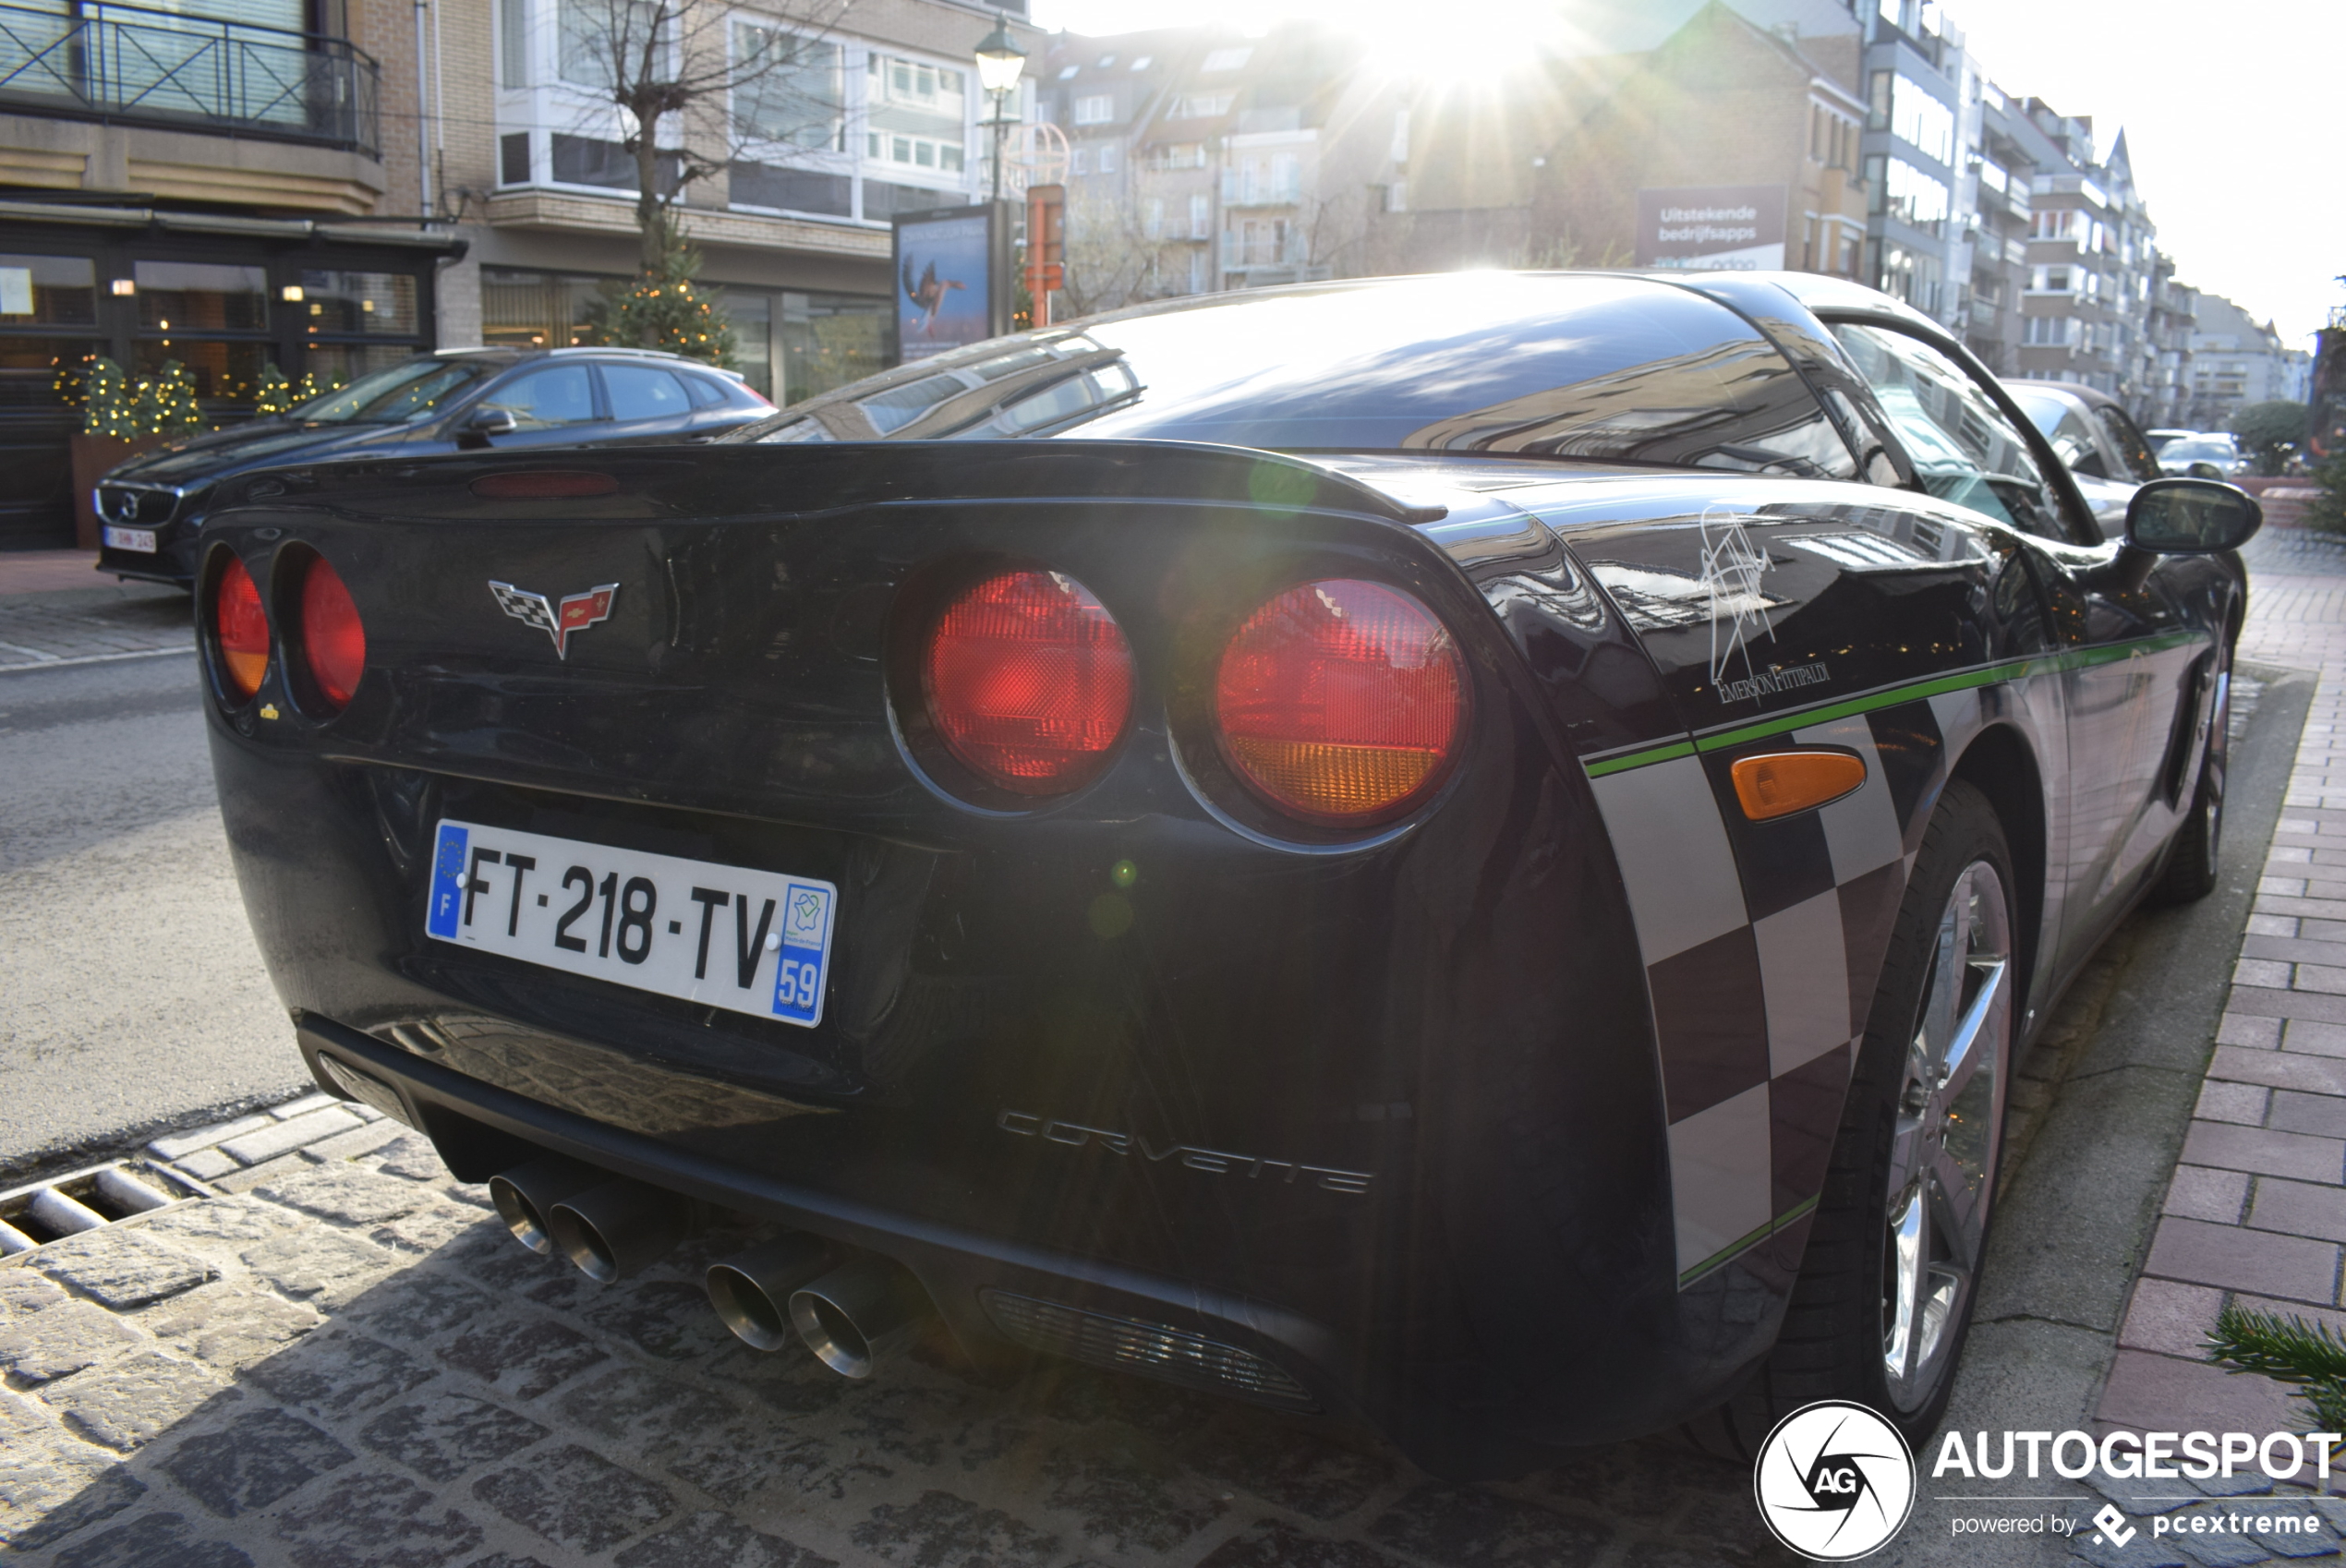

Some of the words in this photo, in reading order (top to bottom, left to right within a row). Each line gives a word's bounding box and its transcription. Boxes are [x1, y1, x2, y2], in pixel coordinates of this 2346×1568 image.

[1661, 206, 1757, 223] Uitstekende
[1658, 226, 1757, 243] bedrijfsapps
[440, 893, 452, 917] F
[779, 959, 817, 1008] 59
[997, 1111, 1375, 1194] CORVETTE
